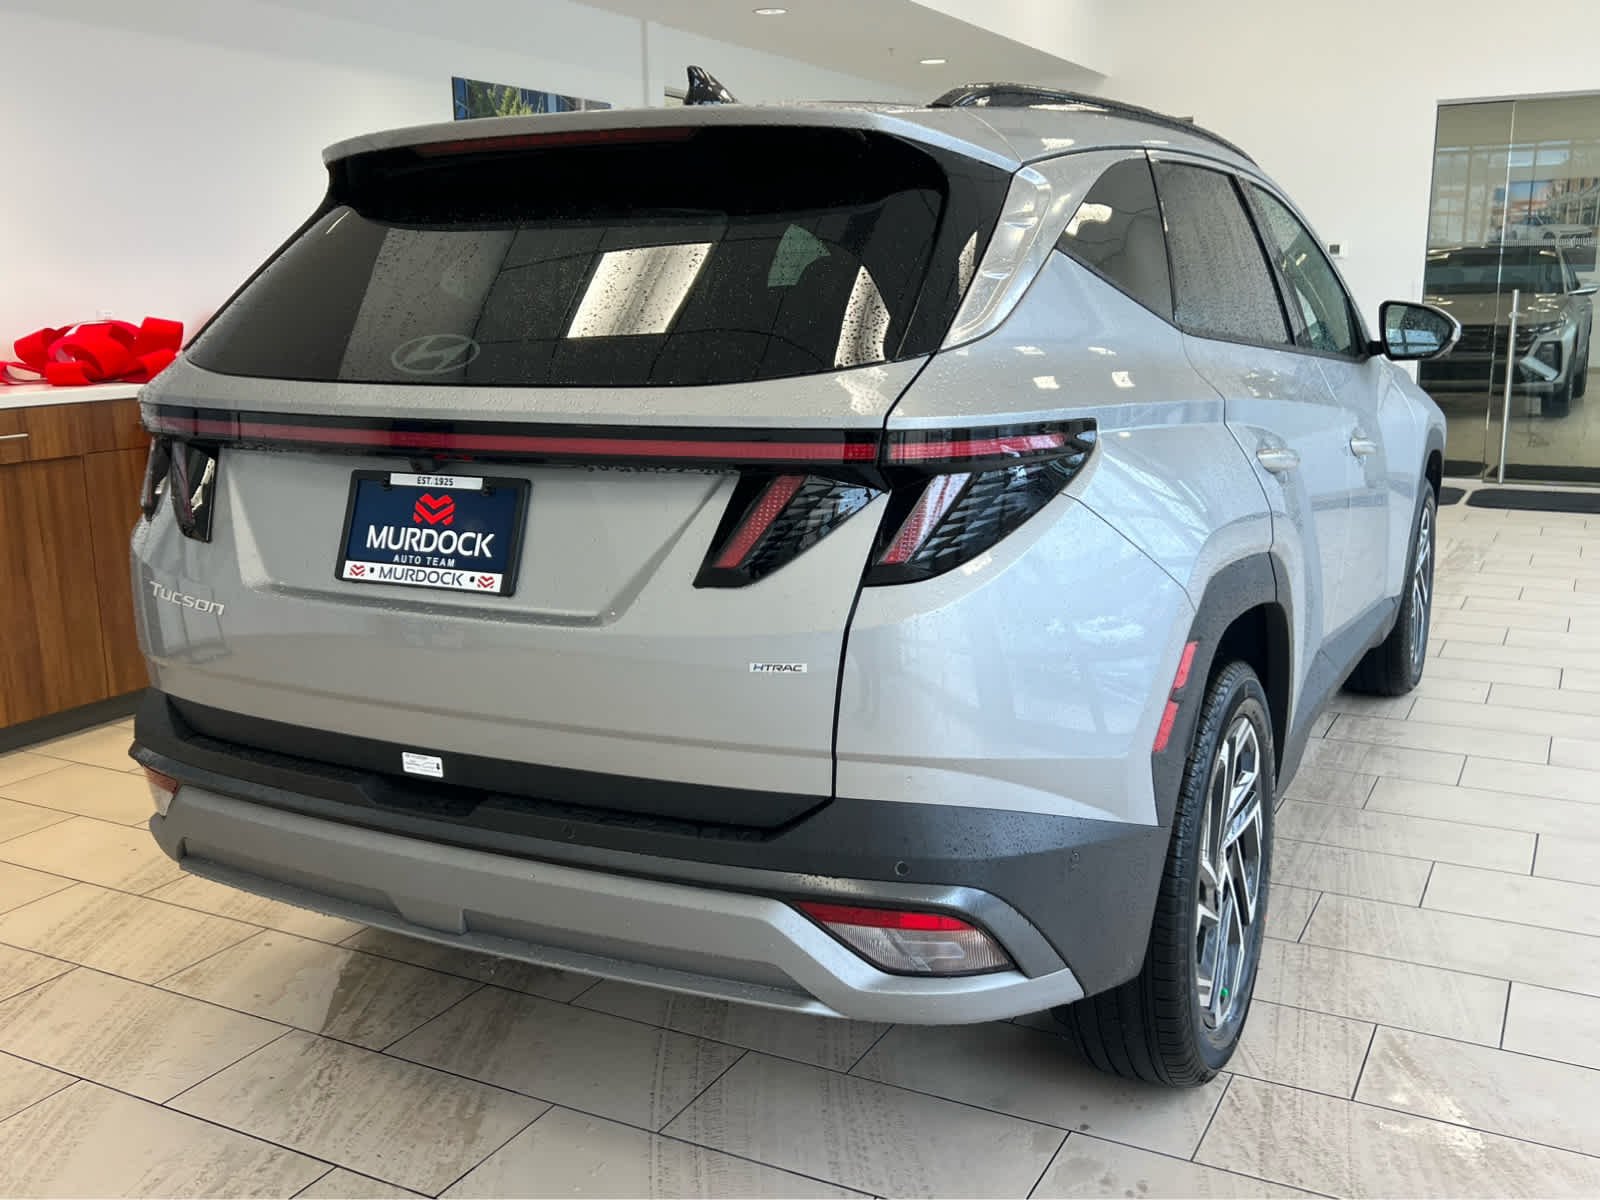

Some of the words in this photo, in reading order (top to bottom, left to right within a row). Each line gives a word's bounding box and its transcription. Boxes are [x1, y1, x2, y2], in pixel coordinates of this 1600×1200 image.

[416, 476, 433, 486] EST.
[434, 477, 454, 487] 1925
[366, 525, 495, 558] MURDOCK
[392, 554, 422, 565] AUTO
[426, 556, 456, 567] TEAM
[378, 566, 464, 587] MURDOCK
[752, 663, 803, 672] HTRAC
